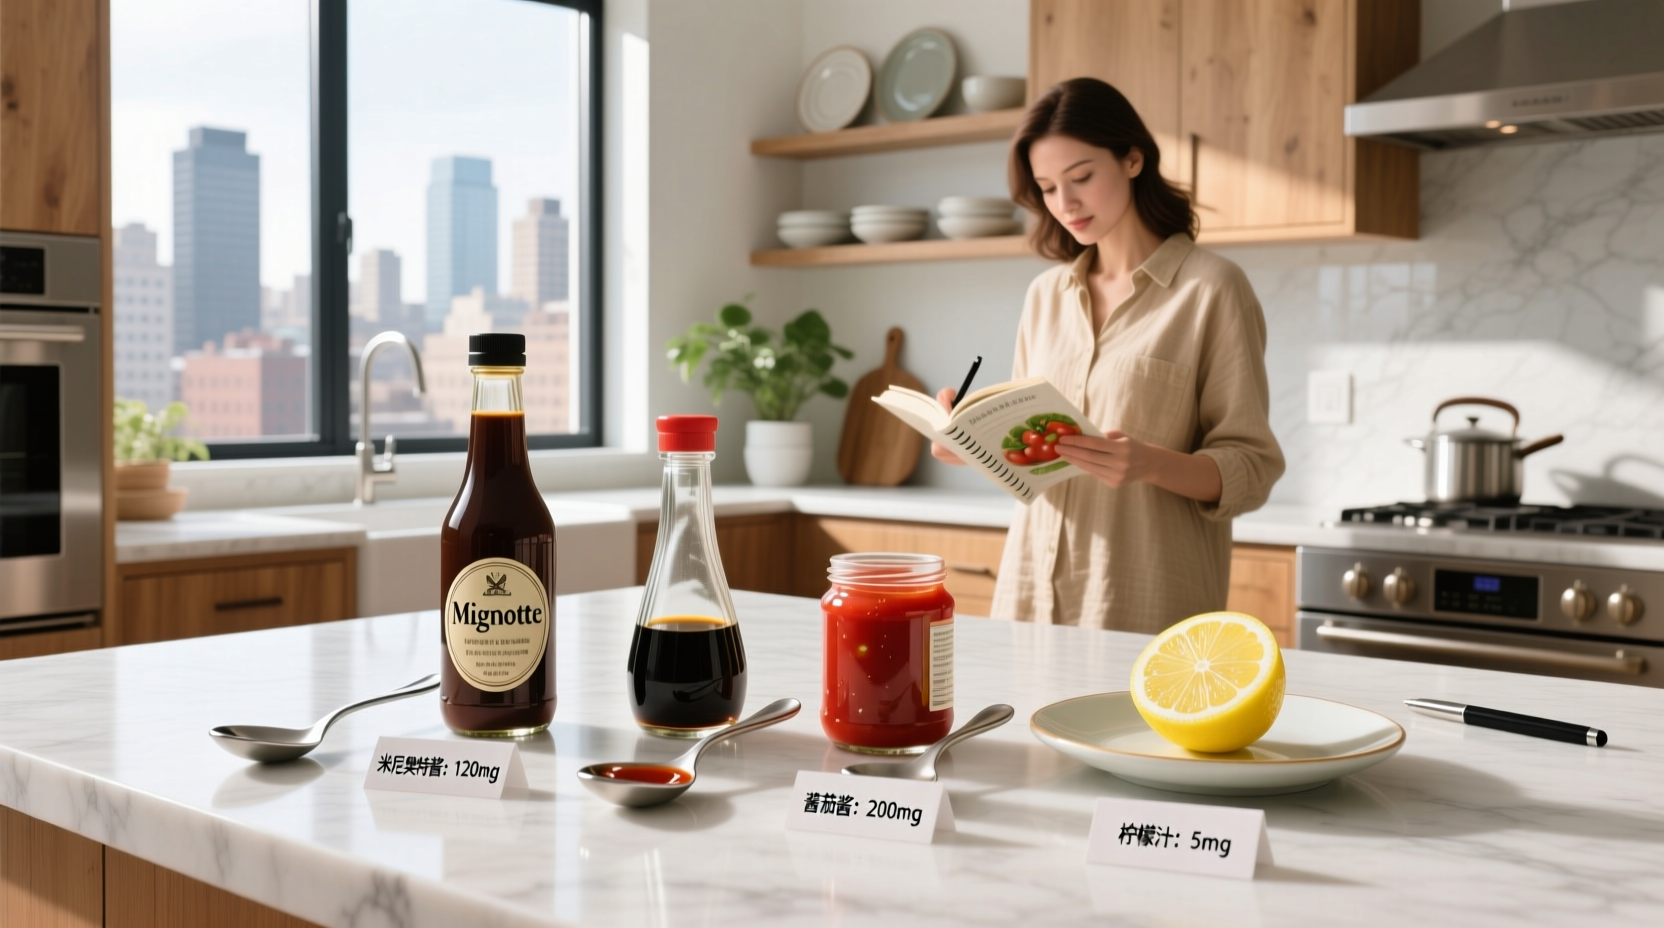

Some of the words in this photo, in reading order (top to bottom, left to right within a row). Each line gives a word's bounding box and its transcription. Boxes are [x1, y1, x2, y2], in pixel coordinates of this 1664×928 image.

[452, 601, 542, 633] Mignotte
[455, 760, 500, 784] 120mg
[866, 799, 922, 827] 200mg
[1190, 831, 1231, 858] 5mg
